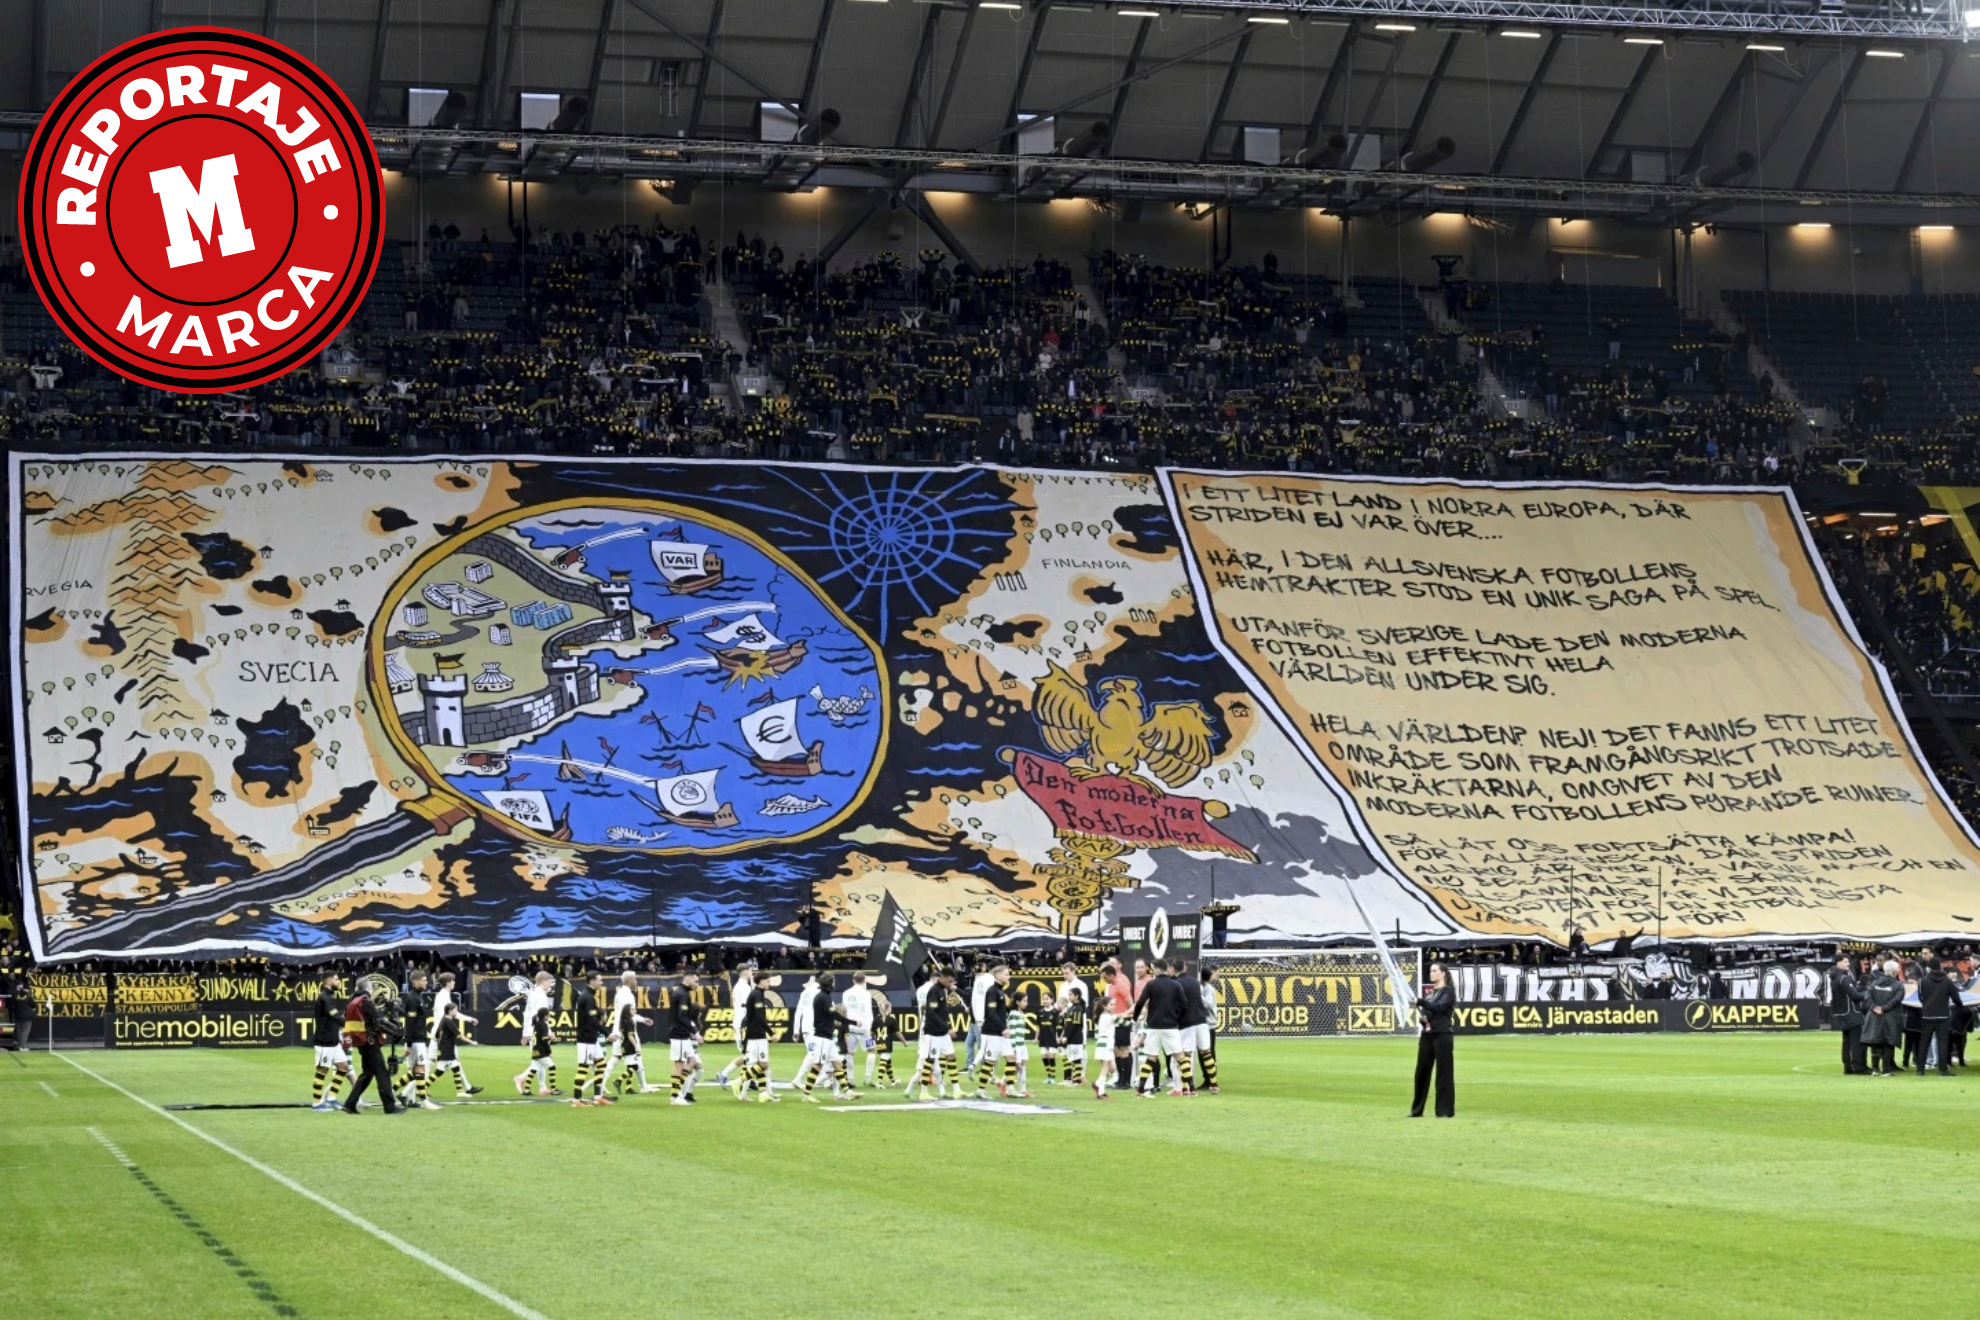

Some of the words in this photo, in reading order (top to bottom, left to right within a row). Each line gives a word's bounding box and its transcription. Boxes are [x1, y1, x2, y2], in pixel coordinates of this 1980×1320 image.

[1184, 484, 1192, 499] I
[1201, 487, 1248, 502] ETT
[1258, 487, 1323, 507] LITET
[1332, 491, 1401, 511] LAND
[1428, 498, 1514, 518] NORRA
[1524, 499, 1626, 519] EUROPA,
[1630, 499, 1691, 520] DÄR
[1188, 506, 1306, 526] STRIDEN
[1315, 511, 1343, 528] EJ
[1355, 514, 1408, 533] VAR
[665, 554, 694, 566] VAR
[1042, 558, 1132, 571] FINLANDIA
[1207, 549, 1274, 574] HÄR,
[1282, 551, 1290, 568] I
[1300, 552, 1352, 571] DEN
[1364, 555, 1535, 585] ALLSVENSKA
[1541, 562, 1697, 588] FOTBOLLENS
[1216, 572, 1392, 598] HEMTRAKTER
[1403, 581, 1472, 601] STOD
[1482, 590, 1516, 608] EN
[1525, 589, 1577, 609] UNIK
[1589, 586, 1665, 611] SAGA
[1673, 578, 1710, 601] PÅ
[1231, 616, 1347, 644] UTANFÖR
[1356, 624, 1474, 646] SVERIGE
[1478, 630, 1551, 653] LADE
[1553, 629, 1611, 653] DEN
[1621, 624, 1748, 648] MODERNA
[1251, 638, 1397, 668] FOTBOLLEN
[1407, 648, 1535, 670] EFFEKTIVT
[1546, 654, 1615, 673] HELA
[238, 660, 340, 684] SVECIA
[1268, 658, 1396, 691] VÄRLDEN
[1406, 671, 1499, 693] UNDER
[1507, 673, 1556, 697] SIG.
[1309, 713, 1378, 741] HELA
[1387, 718, 1527, 747] VÄRLDEN?
[1538, 728, 1597, 750] NEJ!
[1602, 724, 1662, 748] DET
[1669, 716, 1757, 743] FANNS
[1763, 713, 1807, 731] ETT
[1814, 715, 1879, 736] LITET
[1328, 740, 1452, 771] OMRÅDE
[1457, 750, 1521, 772] SOM
[1528, 744, 1760, 775] FRAMGÅNGSRIKT
[1760, 737, 1902, 759] TROTSADE
[1023, 756, 1076, 794] Den
[1086, 785, 1196, 821] moderna
[1347, 768, 1553, 803] INKRÄKTARNA,
[1561, 772, 1674, 800] OMGIVET
[1683, 771, 1715, 790] AV
[1721, 763, 1783, 791] DEN
[1365, 796, 1505, 822] MODERNA
[1512, 793, 1688, 822] FOTBOLLENS
[1690, 785, 1823, 814] PYRANDE
[509, 811, 544, 823] FIFA
[1071, 840, 1113, 853] VAR
[1439, 836, 1496, 850] LÅT
[1507, 837, 1568, 853] OSS
[1574, 832, 1736, 853] FORTSÄTTA
[1745, 828, 1857, 847] KÄMPA!
[1397, 846, 1454, 861] FÖR
[1459, 853, 1470, 864] I
[1697, 845, 1768, 860] DÄR
[1771, 844, 1892, 862] STRIDEN
[1530, 863, 1575, 876] ÄR
[1928, 858, 1967, 871] EN
[1739, 885, 1798, 898] DEN
[1809, 883, 1902, 901] SISTA
[1676, 909, 1745, 926] FÖR!
[1123, 926, 1146, 941] UNIBET
[1173, 924, 1197, 940] UNIBET
[29, 973, 79, 987] NORRA
[117, 974, 196, 988] KYRIAKOS
[200, 978, 270, 1001] SUNDSVALL
[126, 989, 188, 1001] KENNY
[1229, 1006, 1309, 1025] PROJOB
[1352, 1008, 1391, 1027] XL
[1513, 1006, 1541, 1022] ICA
[1547, 1003, 1658, 1029] Järvastaden
[1712, 1005, 1799, 1024] KAPPEX
[114, 1014, 284, 1038] themobilelife
